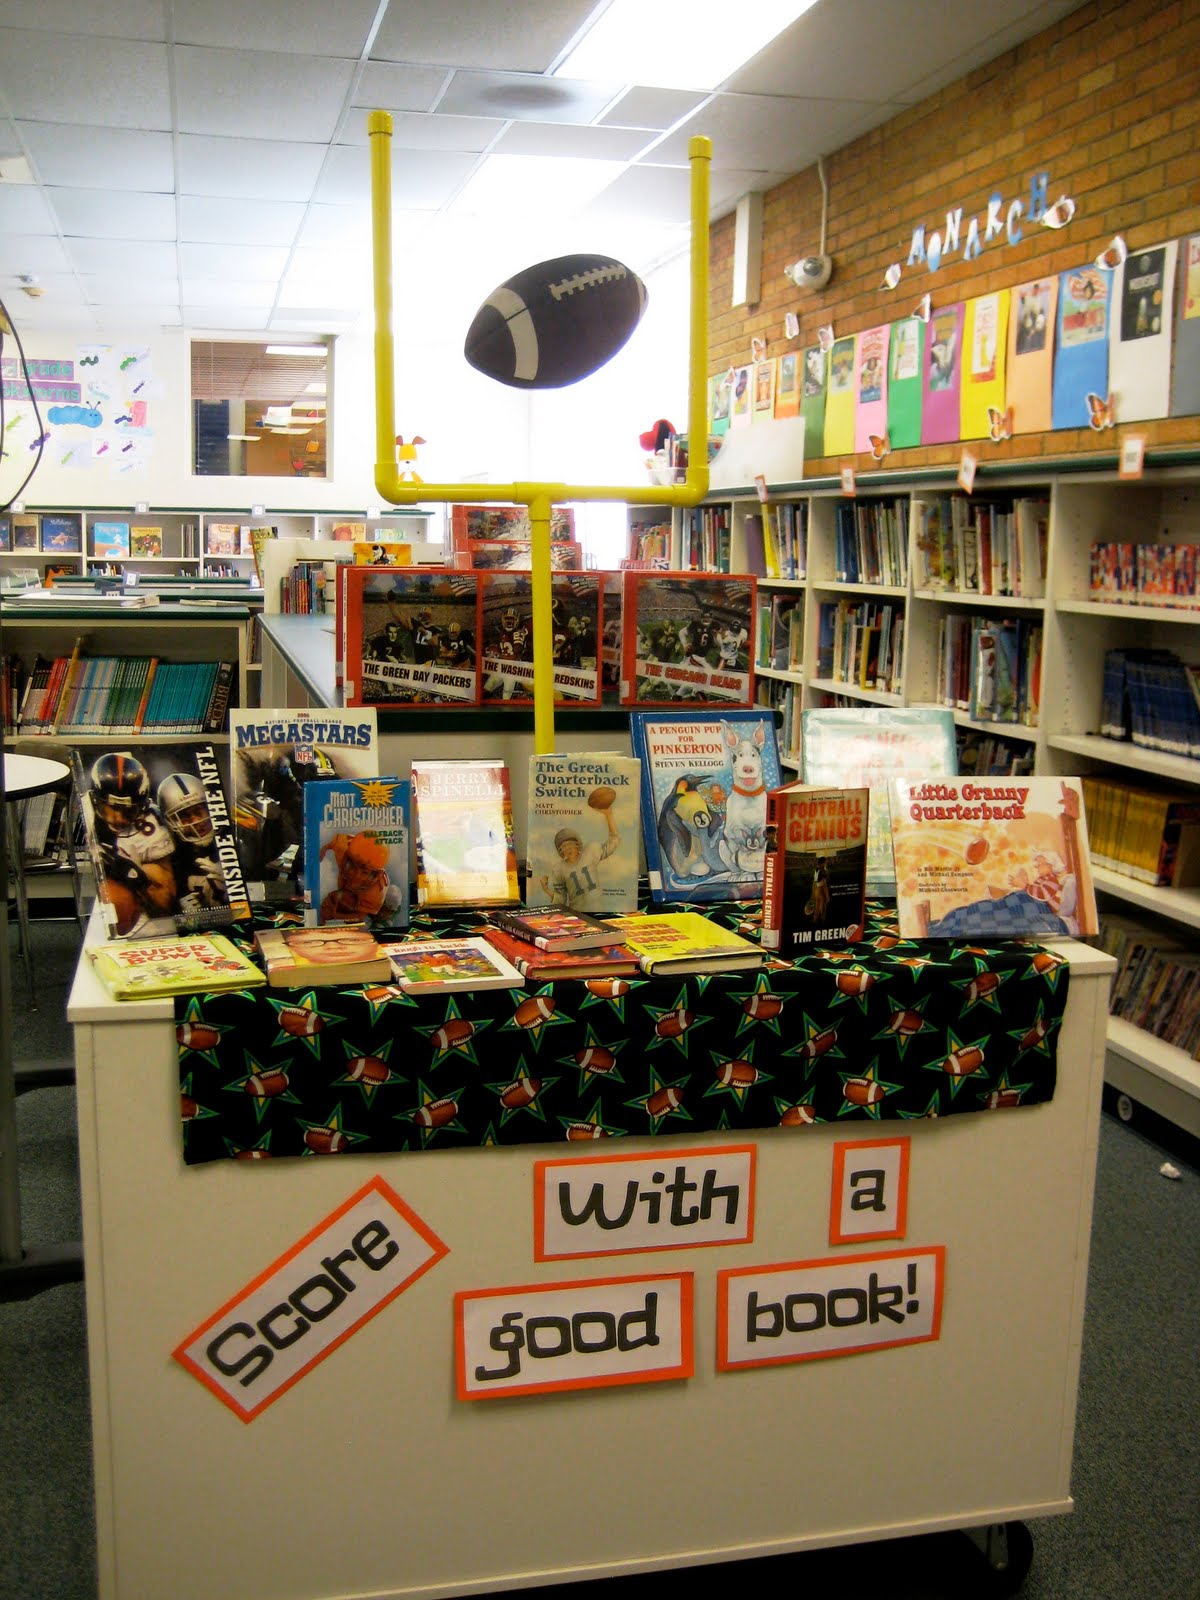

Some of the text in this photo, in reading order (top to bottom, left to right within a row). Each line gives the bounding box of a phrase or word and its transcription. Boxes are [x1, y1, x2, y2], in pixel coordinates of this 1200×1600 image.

[364, 662, 472, 689] THE GREEN BAY PACKERS
[483, 660, 595, 690] THE WASHIN REDSKINS
[645, 663, 743, 691] THE CHICAGO BEARS
[235, 723, 372, 748] MEGASTARS
[649, 725, 722, 735] A PENGUIN PUP
[678, 735, 695, 743] FOR
[296, 751, 313, 762] NFL
[652, 743, 723, 755] PINKERTON
[195, 746, 221, 786] NFL
[535, 761, 610, 774] The Great
[655, 760, 686, 769] STEVEN
[434, 772, 490, 785] JERRY
[535, 773, 630, 786] Quarterback
[329, 791, 356, 808] MATT
[421, 784, 506, 797] SPINELLI
[535, 786, 586, 798] Switch
[909, 783, 1029, 805] Little Granny
[205, 789, 231, 831] THE
[323, 803, 405, 828] CHRISTOPHER
[789, 799, 863, 819] FOOTBALL
[910, 802, 1026, 822] Quarterback
[364, 829, 404, 839] HALFBACK
[789, 816, 862, 843] GENIUS
[374, 837, 404, 845] ATTACK
[214, 833, 248, 902] INSIDE
[764, 857, 774, 897] FOOTBALL
[763, 899, 773, 930] GENIUS
[792, 927, 847, 944] TIM GREEN
[118, 944, 211, 961] SUPER
[126, 951, 214, 966] BOWL
[849, 1168, 886, 1213] a
[205, 1217, 401, 1388] Score
[474, 1263, 920, 1382] good book!
